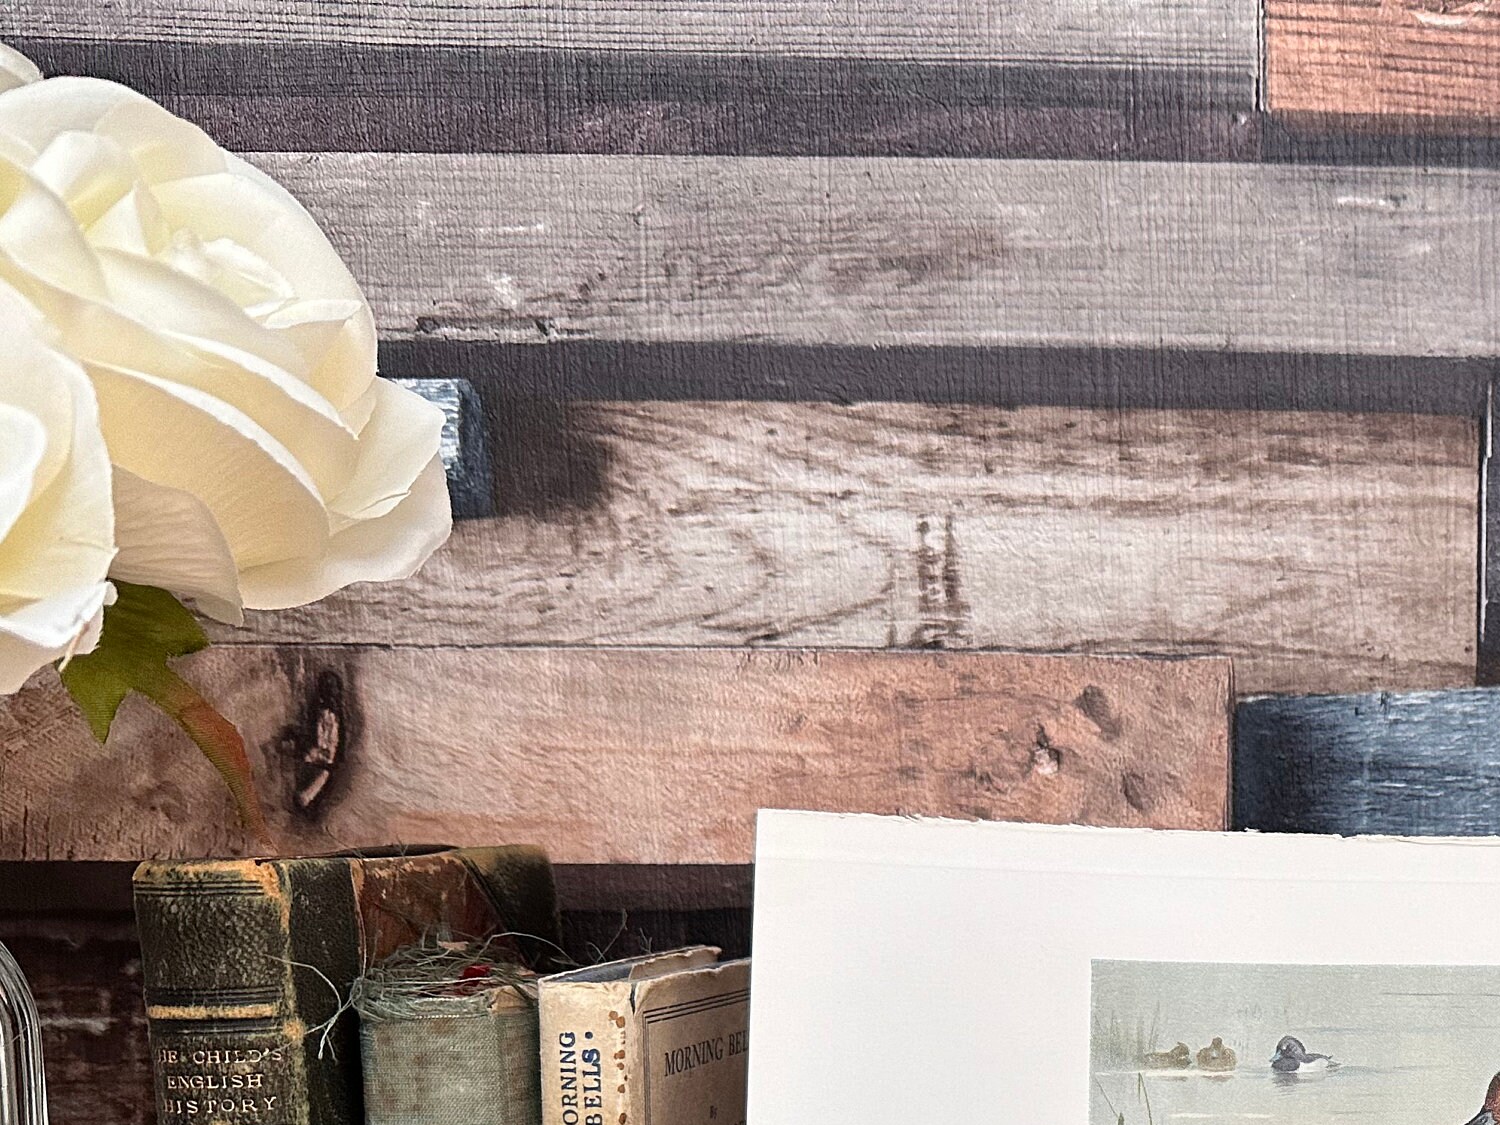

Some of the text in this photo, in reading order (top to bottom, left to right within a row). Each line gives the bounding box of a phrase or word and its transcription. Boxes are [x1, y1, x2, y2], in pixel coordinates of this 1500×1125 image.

[192, 1046, 283, 1065] CHILD'S
[664, 1029, 749, 1077] MORNING BEL
[166, 1073, 265, 1090] ENGLISH
[163, 1096, 278, 1115] HISTORY
